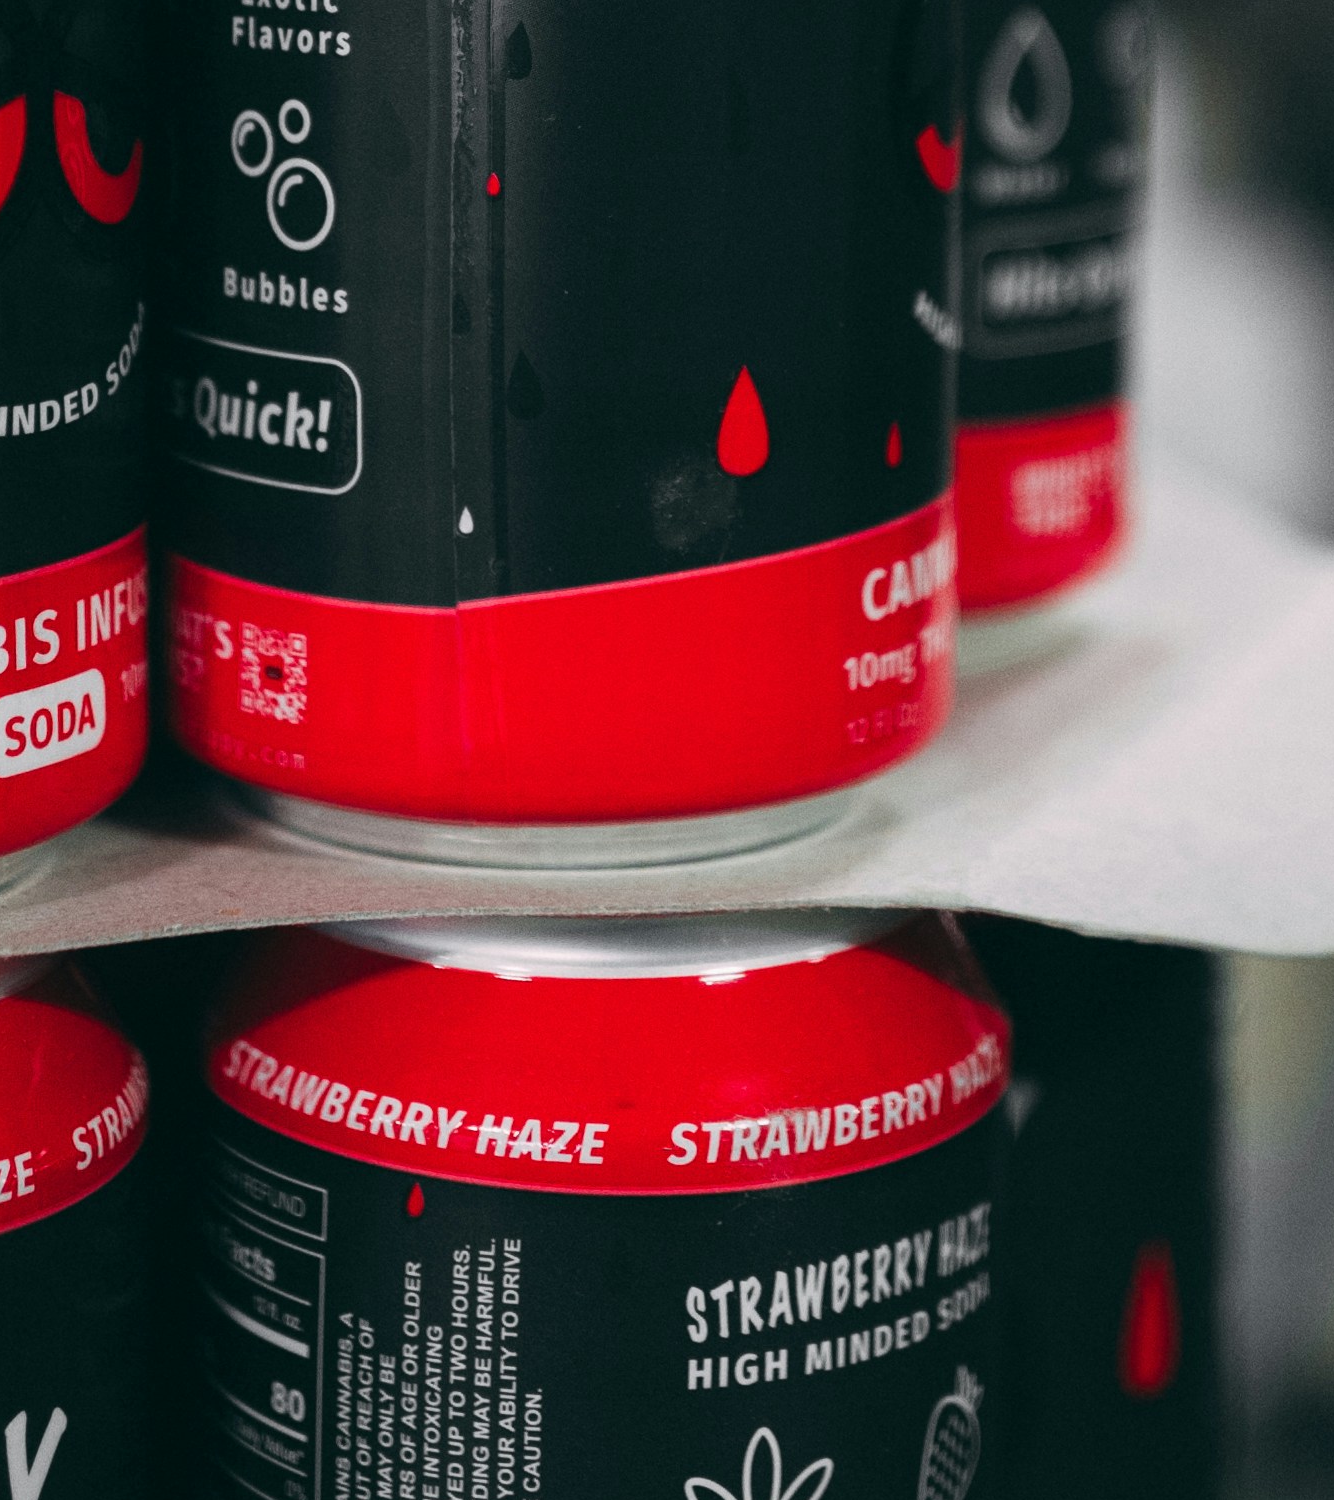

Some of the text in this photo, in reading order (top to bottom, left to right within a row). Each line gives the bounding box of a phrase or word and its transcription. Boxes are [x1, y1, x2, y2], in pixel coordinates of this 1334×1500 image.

[231, 16, 353, 58] Flavors
[223, 269, 350, 314] Bubbles
[191, 376, 333, 454] Quick!
[3, 691, 97, 759] SODA
[223, 1040, 945, 1168] STRAWBERRY HAZE STRAWBERRY
[451, 1244, 470, 1328] HOURS.
[476, 1239, 495, 1351] HARMFUL.
[503, 1238, 521, 1305] DRIVE
[685, 1230, 930, 1346] STRAWBERRY
[501, 1311, 518, 1340] TO
[686, 1314, 931, 1390] HIGH MINDED
[450, 1334, 468, 1384] TWO
[475, 1357, 491, 1387] BE
[498, 1347, 517, 1432] ABILITY
[269, 1381, 306, 1423] 80
[449, 1391, 465, 1420] TO
[473, 1393, 490, 1440] MAY
[448, 1426, 465, 1456] UP
[496, 1437, 515, 1500] YOUR
[523, 1388, 542, 1492] CAUTION.
